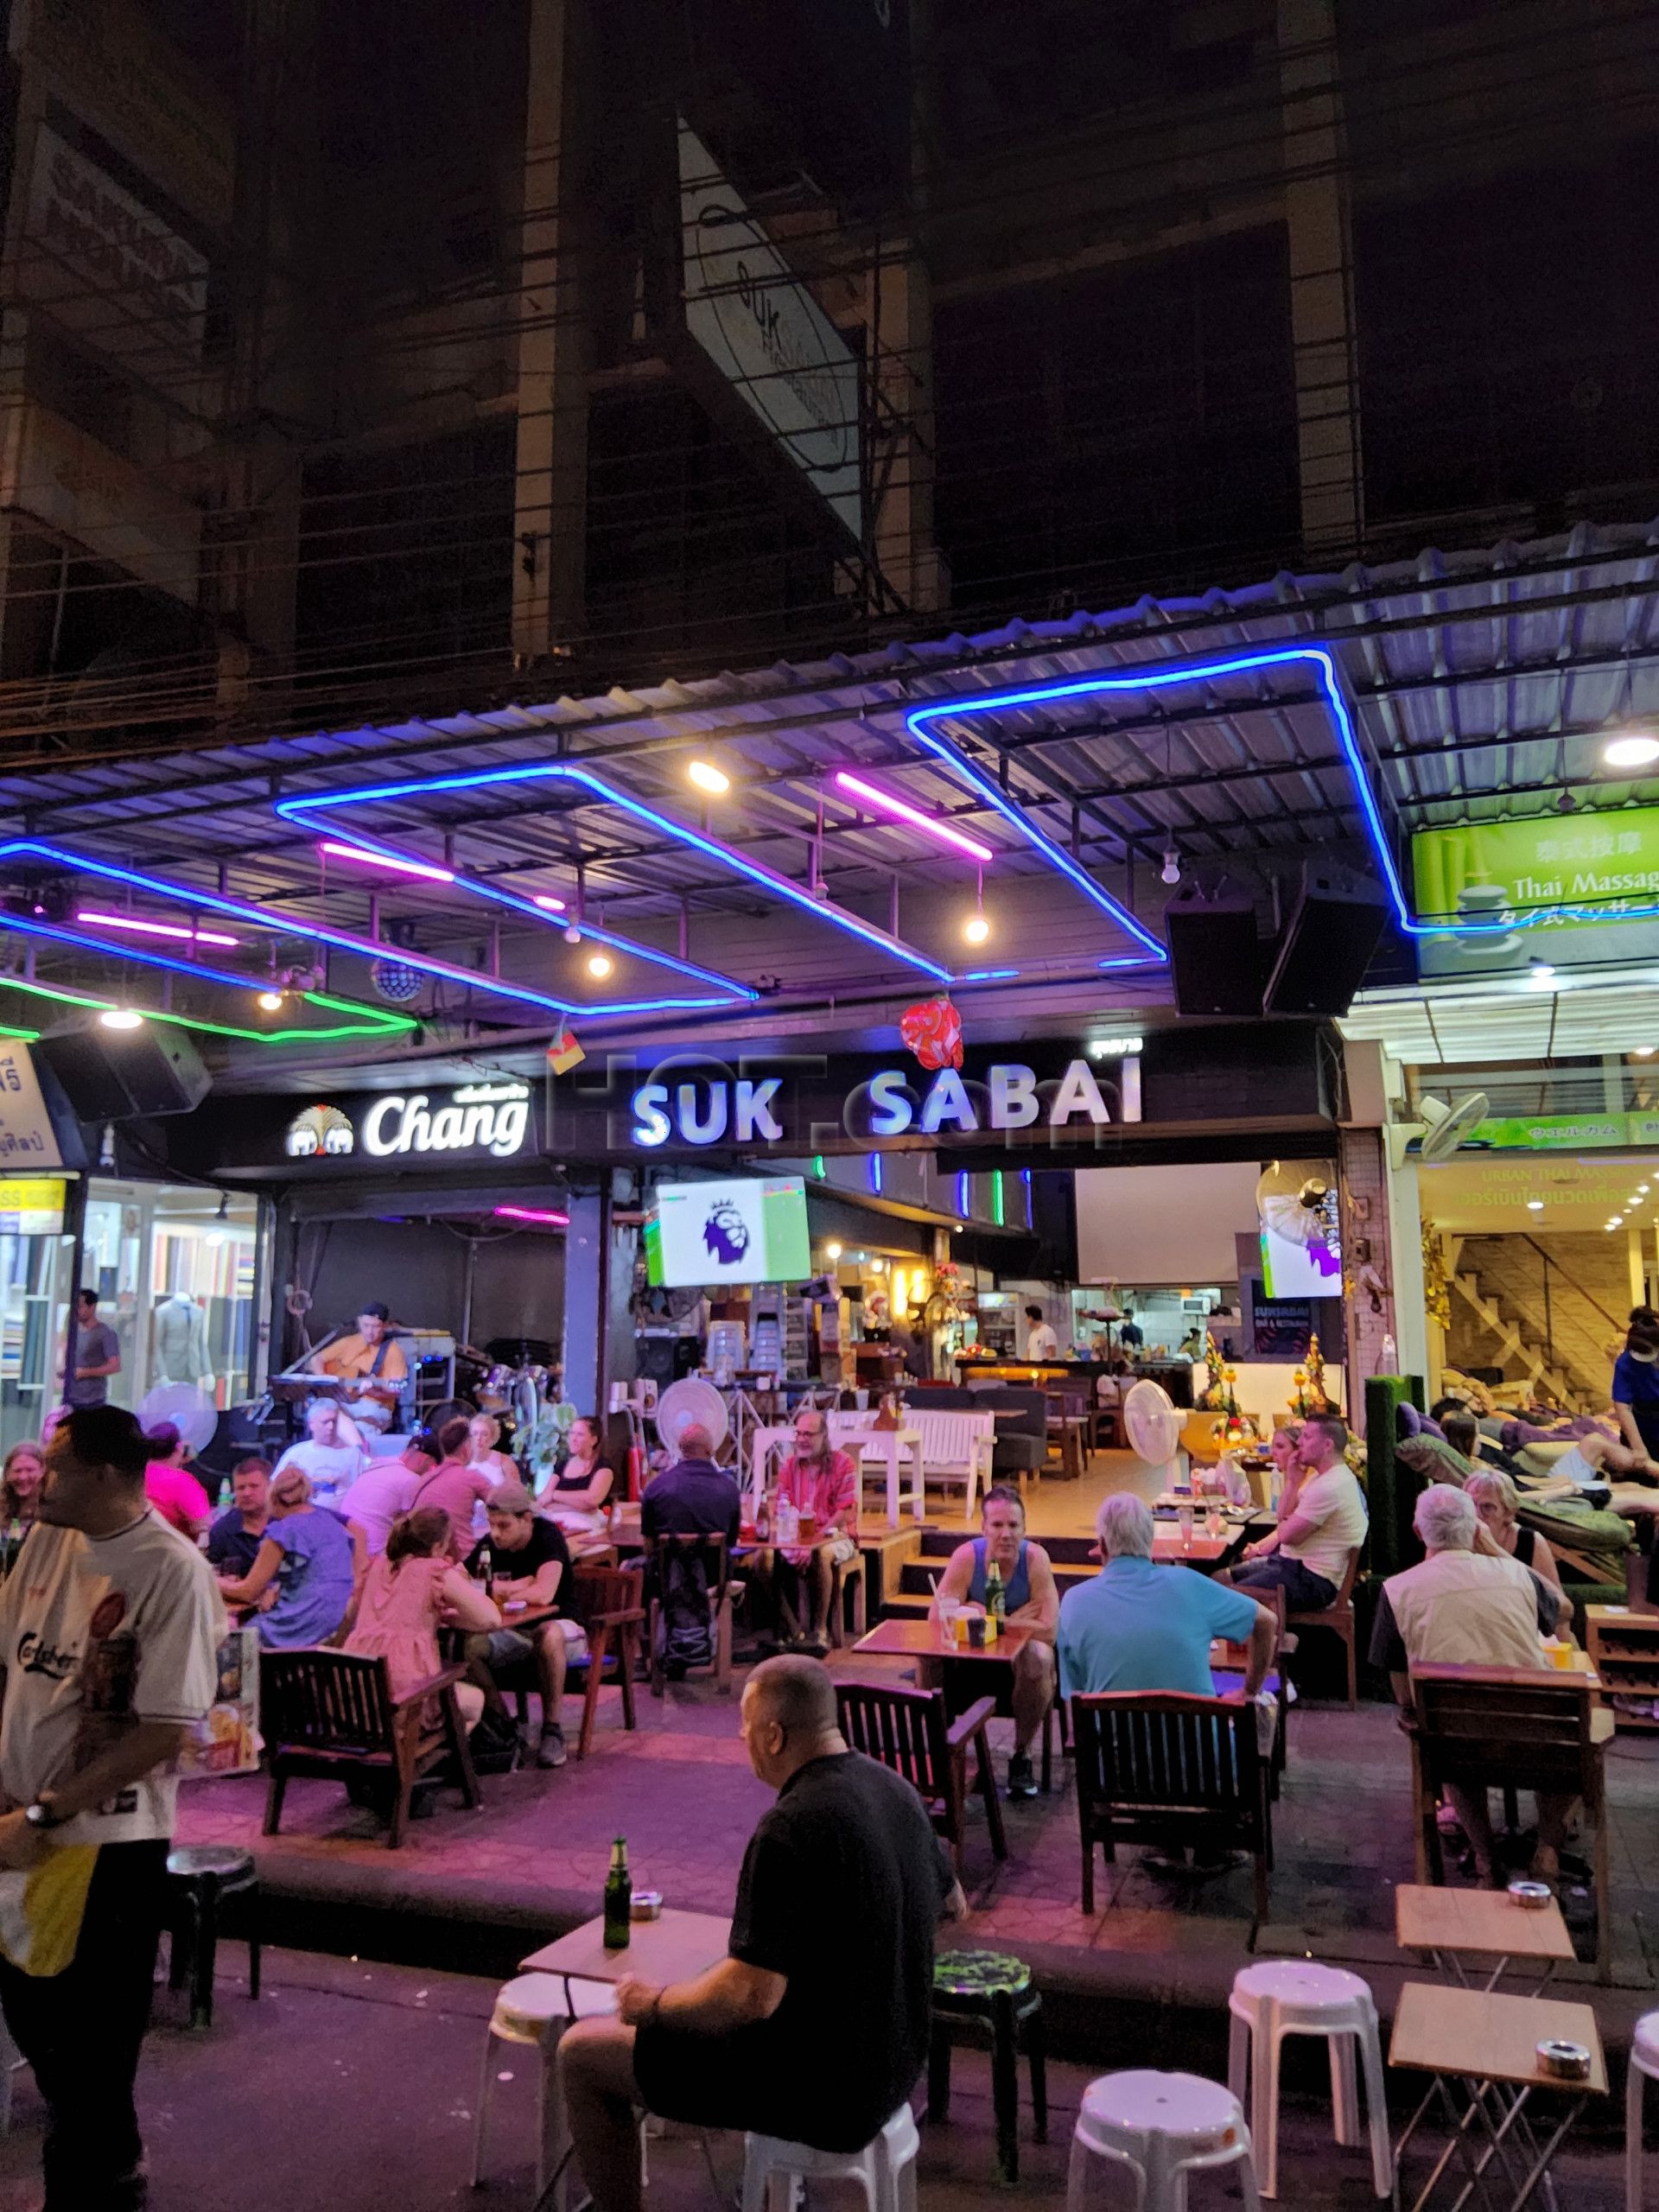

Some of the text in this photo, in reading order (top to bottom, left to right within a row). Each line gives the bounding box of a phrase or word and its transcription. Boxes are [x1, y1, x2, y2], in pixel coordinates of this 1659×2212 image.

[1512, 873, 1563, 899] Thai
[632, 1057, 1142, 1147] SUK SABAI
[363, 1095, 530, 1158] Chang
[1481, 1169, 1532, 1183] URBAN
[1539, 1167, 1570, 1180] THAI
